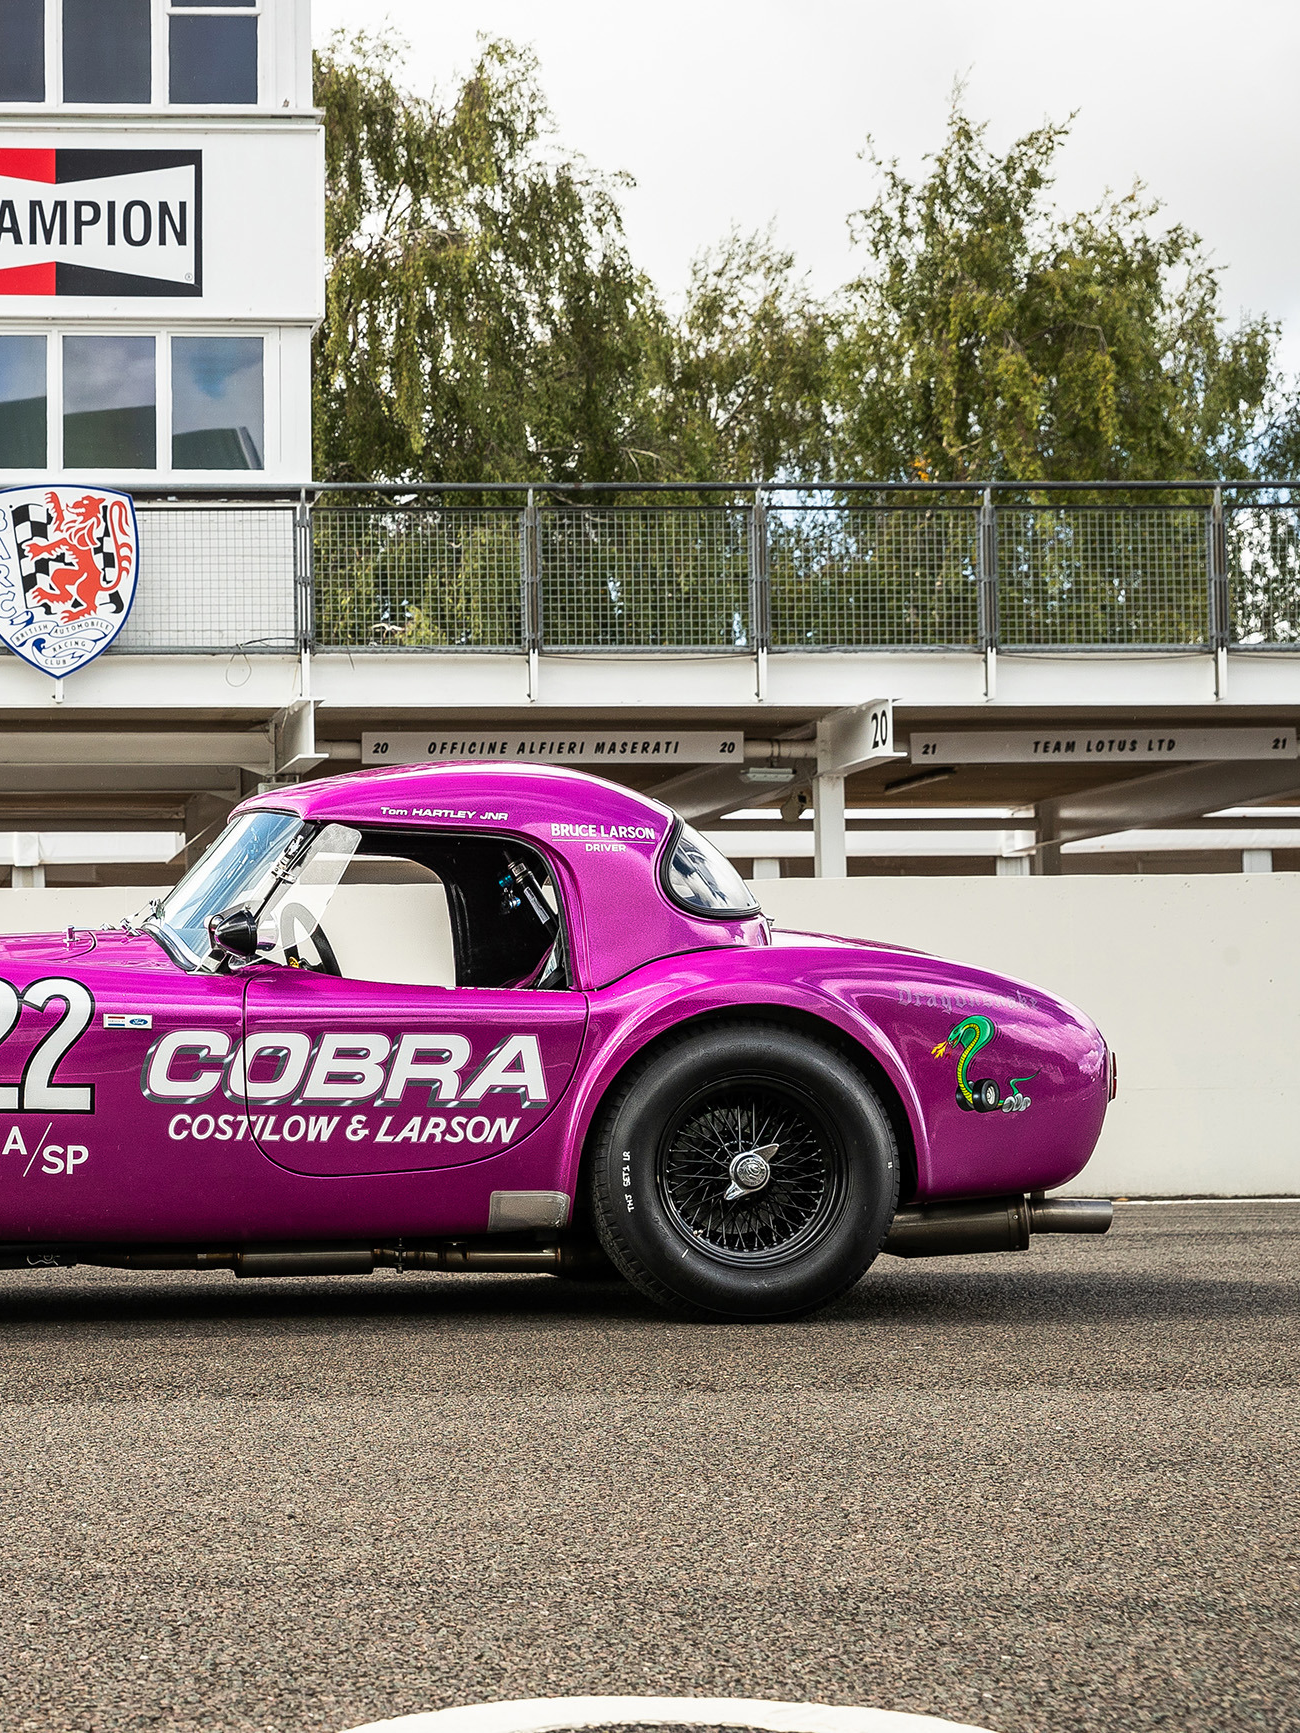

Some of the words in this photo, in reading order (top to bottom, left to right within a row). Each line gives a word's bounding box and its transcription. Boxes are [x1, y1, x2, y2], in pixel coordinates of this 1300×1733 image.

[15, 623, 48, 642] BRITISH
[53, 620, 110, 635] AUTOMOBILE
[52, 640, 86, 653] RACING
[44, 658, 67, 666] CLUB
[871, 709, 888, 749] 20
[372, 742, 389, 755] 20
[427, 742, 509, 755] OFFICINE
[516, 742, 585, 755] ALFIERI
[594, 742, 681, 755] MASERATI
[719, 741, 736, 754] 20
[922, 743, 937, 755] 21
[1033, 740, 1076, 754] TEAM
[1086, 739, 1138, 753] LOTUS
[1147, 738, 1176, 752] LTD
[1272, 737, 1288, 750] 21
[380, 806, 408, 817] Tom
[411, 808, 476, 820] HARTLEY
[479, 810, 509, 821] JNR
[551, 823, 598, 838] BRUCE
[600, 824, 656, 840] LARSON
[585, 843, 627, 852] DRIVER
[896, 986, 1039, 1015] Dragonsnake
[140, 1029, 549, 1109] COBRA
[168, 1113, 340, 1143] COSTILOW
[345, 1115, 370, 1139] &
[373, 1115, 523, 1144] LARSON
[622, 1151, 631, 1161] LR
